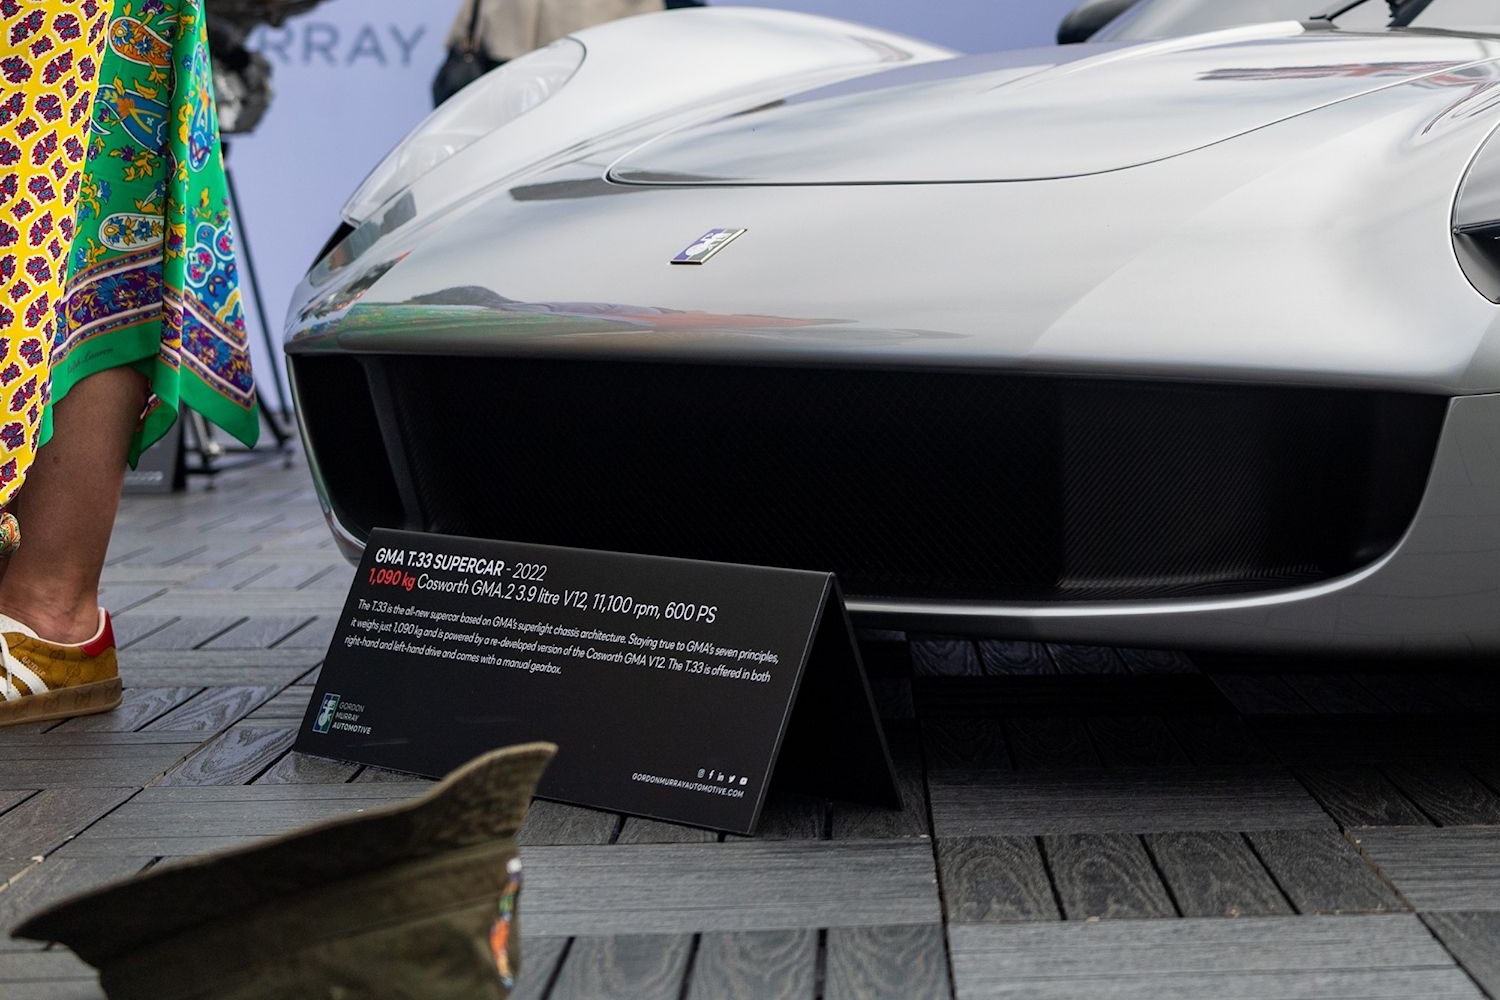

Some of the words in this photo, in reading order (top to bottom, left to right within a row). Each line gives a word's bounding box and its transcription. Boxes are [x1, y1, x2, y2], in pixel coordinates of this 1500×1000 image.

[261, 21, 427, 68] RRAY
[375, 547, 404, 565] GMA
[407, 551, 434, 569] T.33
[432, 553, 504, 577] SUPERCAR
[512, 562, 548, 582] 2022
[368, 567, 401, 586] 1,090
[402, 572, 416, 591] kg
[417, 573, 469, 596] Cosworth
[471, 579, 515, 600] GMA.2
[515, 584, 537, 602] 3.9
[537, 587, 561, 605] litre
[563, 589, 588, 611] V12,
[592, 593, 633, 614] 11,100
[633, 602, 661, 620] rpm,
[664, 601, 695, 621] 600
[696, 604, 718, 624] PS
[350, 617, 357, 627] it
[357, 619, 379, 632] weighs
[378, 621, 392, 633] just
[392, 621, 415, 635] 1,090
[414, 625, 423, 638] kg
[423, 627, 437, 639] and
[437, 629, 443, 640] is
[443, 631, 476, 644] powered
[474, 632, 484, 646] by
[484, 635, 490, 645] a
[490, 637, 538, 652] re-developed
[537, 643, 562, 655] version
[563, 645, 572, 656] of
[572, 646, 585, 658] the
[586, 648, 623, 663] Cosworth
[623, 652, 647, 666] GMA
[648, 655, 666, 670] V12.
[668, 658, 683, 671] The
[685, 660, 704, 674] T.33
[703, 663, 711, 675] is
[711, 664, 742, 679] offered
[742, 668, 751, 680] in
[751, 670, 771, 683] both
[358, 599, 370, 611] The
[371, 600, 387, 613] T.33
[387, 603, 393, 614] is
[393, 604, 404, 615] the
[404, 605, 429, 619] all-new
[429, 610, 460, 623] supercar
[460, 612, 483, 626] based
[482, 617, 492, 626] on
[492, 616, 518, 630] GMA's
[518, 622, 554, 636] superlight
[553, 624, 580, 639] chassis
[580, 629, 627, 645] architecture.
[628, 633, 657, 651] Staying
[658, 638, 675, 650] true
[676, 639, 686, 651] to
[686, 640, 715, 655] GMA's
[715, 646, 738, 658] seven
[737, 649, 779, 665] principles,
[344, 635, 380, 649] right-hand
[380, 639, 394, 651] and
[393, 641, 425, 655] left-hand
[424, 645, 442, 658] drive
[442, 649, 457, 660] and
[456, 651, 480, 663] comes
[480, 654, 496, 665] with
[496, 658, 502, 666] a
[502, 659, 531, 671] manual
[530, 662, 562, 675] gearbox.
[335, 711, 360, 721] MURRAY
[339, 701, 365, 712] GORDON
[332, 721, 372, 735] AUTOMOTIVE
[632, 772, 745, 798] GORDONMURRAYAUTOMOTIVE.COM
